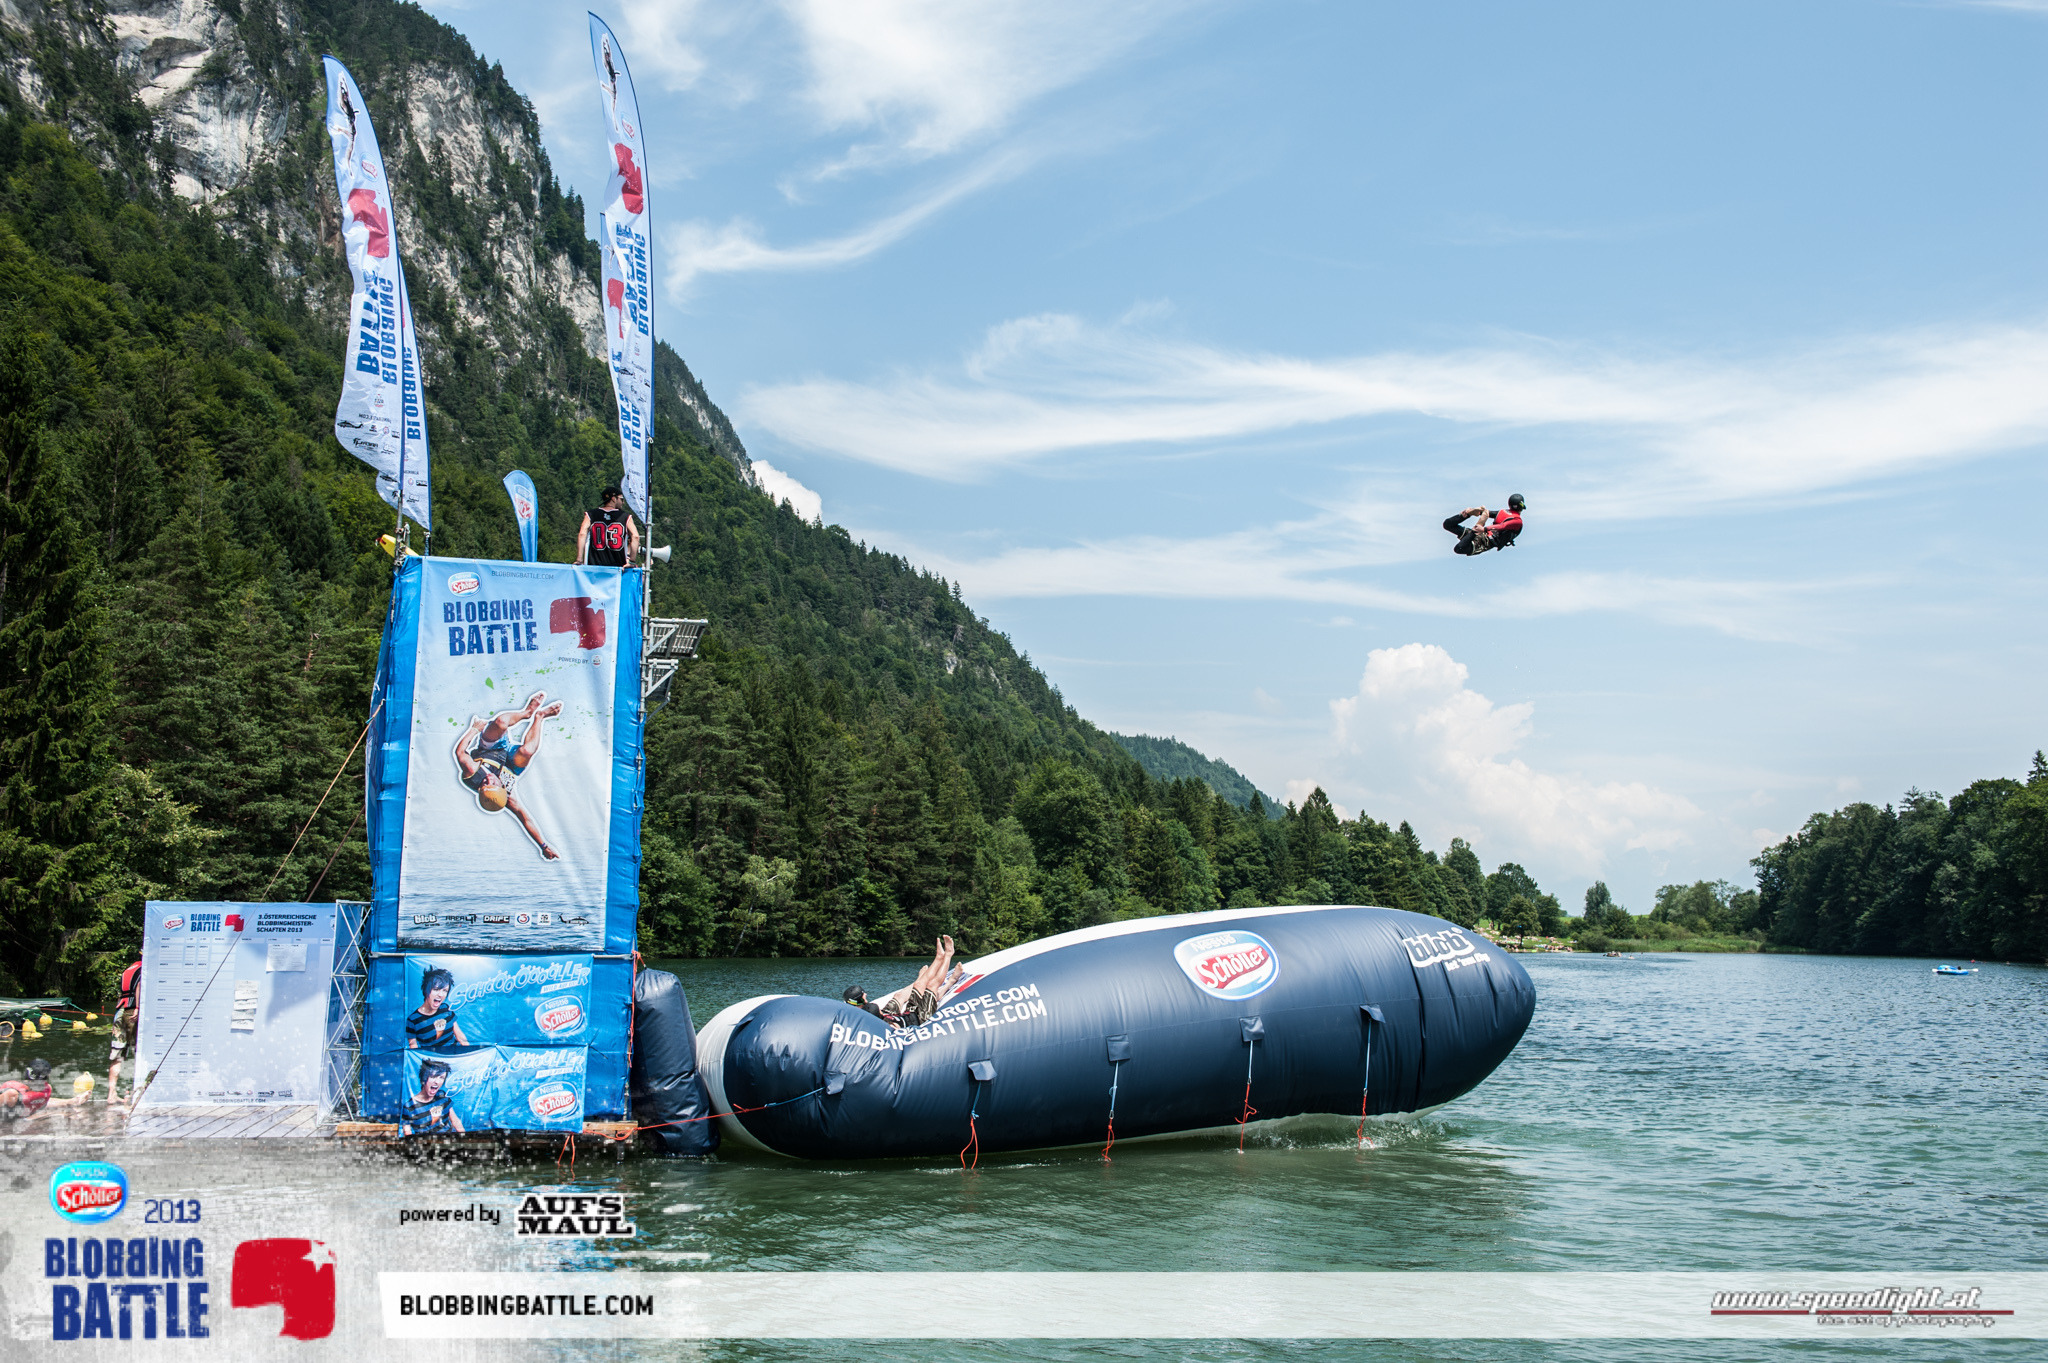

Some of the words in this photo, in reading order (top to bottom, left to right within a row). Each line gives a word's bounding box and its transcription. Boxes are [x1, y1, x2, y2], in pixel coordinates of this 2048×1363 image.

[591, 521, 625, 550] 03
[491, 570, 554, 580] BLOBBINGBATTLE.COM
[444, 599, 533, 623] BLOBBING
[449, 621, 538, 656] BATTLE
[190, 922, 221, 932] BATTLE
[414, 914, 437, 924] blob
[1189, 933, 1237, 952] Nestlé
[1402, 929, 1476, 968] blob
[1196, 947, 1265, 989] Schöller
[545, 998, 569, 1010] Nestlé
[543, 1008, 579, 1031] Schöller
[536, 1094, 574, 1116] Schöller
